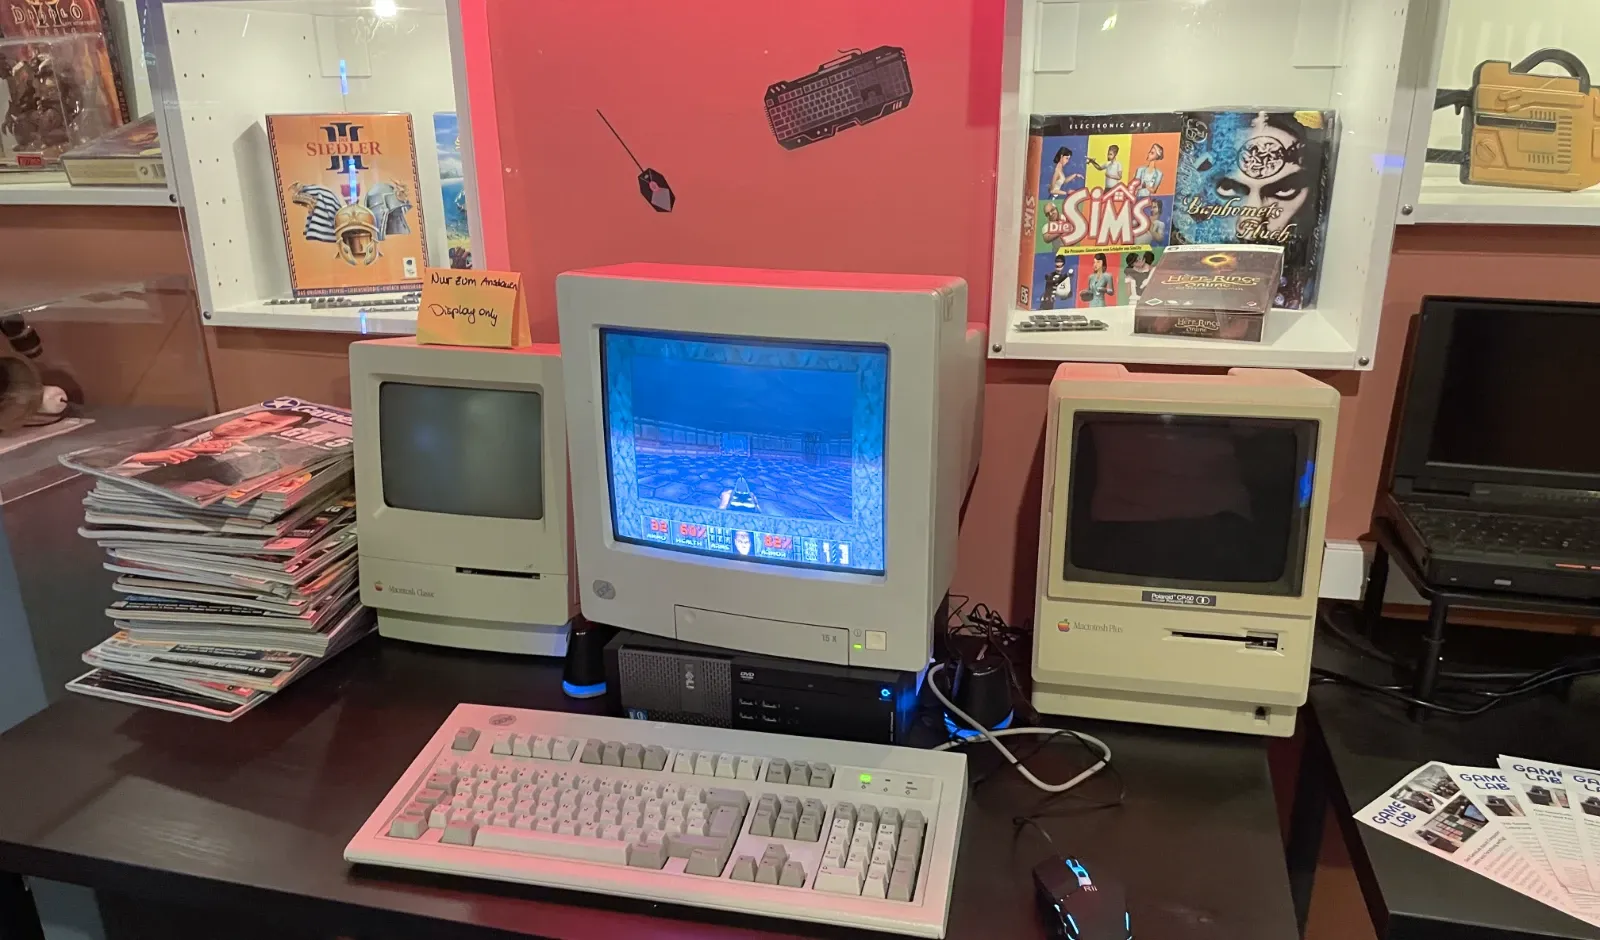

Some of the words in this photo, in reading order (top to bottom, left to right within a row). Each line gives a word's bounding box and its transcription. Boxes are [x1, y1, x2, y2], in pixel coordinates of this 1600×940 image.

[1069, 122, 1124, 130] ELECTRONIC
[306, 141, 382, 157] SIEDLER
[1184, 197, 1283, 219] Baphomets
[1049, 221, 1070, 232] Die
[1237, 219, 1297, 242] Fluch
[431, 272, 452, 285] Nur
[428, 304, 475, 324] Display
[478, 308, 498, 327] only
[1073, 622, 1109, 632] Macintosh
[1109, 625, 1124, 633] Plus
[1473, 782, 1510, 791] LAB
[1372, 801, 1406, 824] GAME
[1390, 811, 1417, 828] LAB
